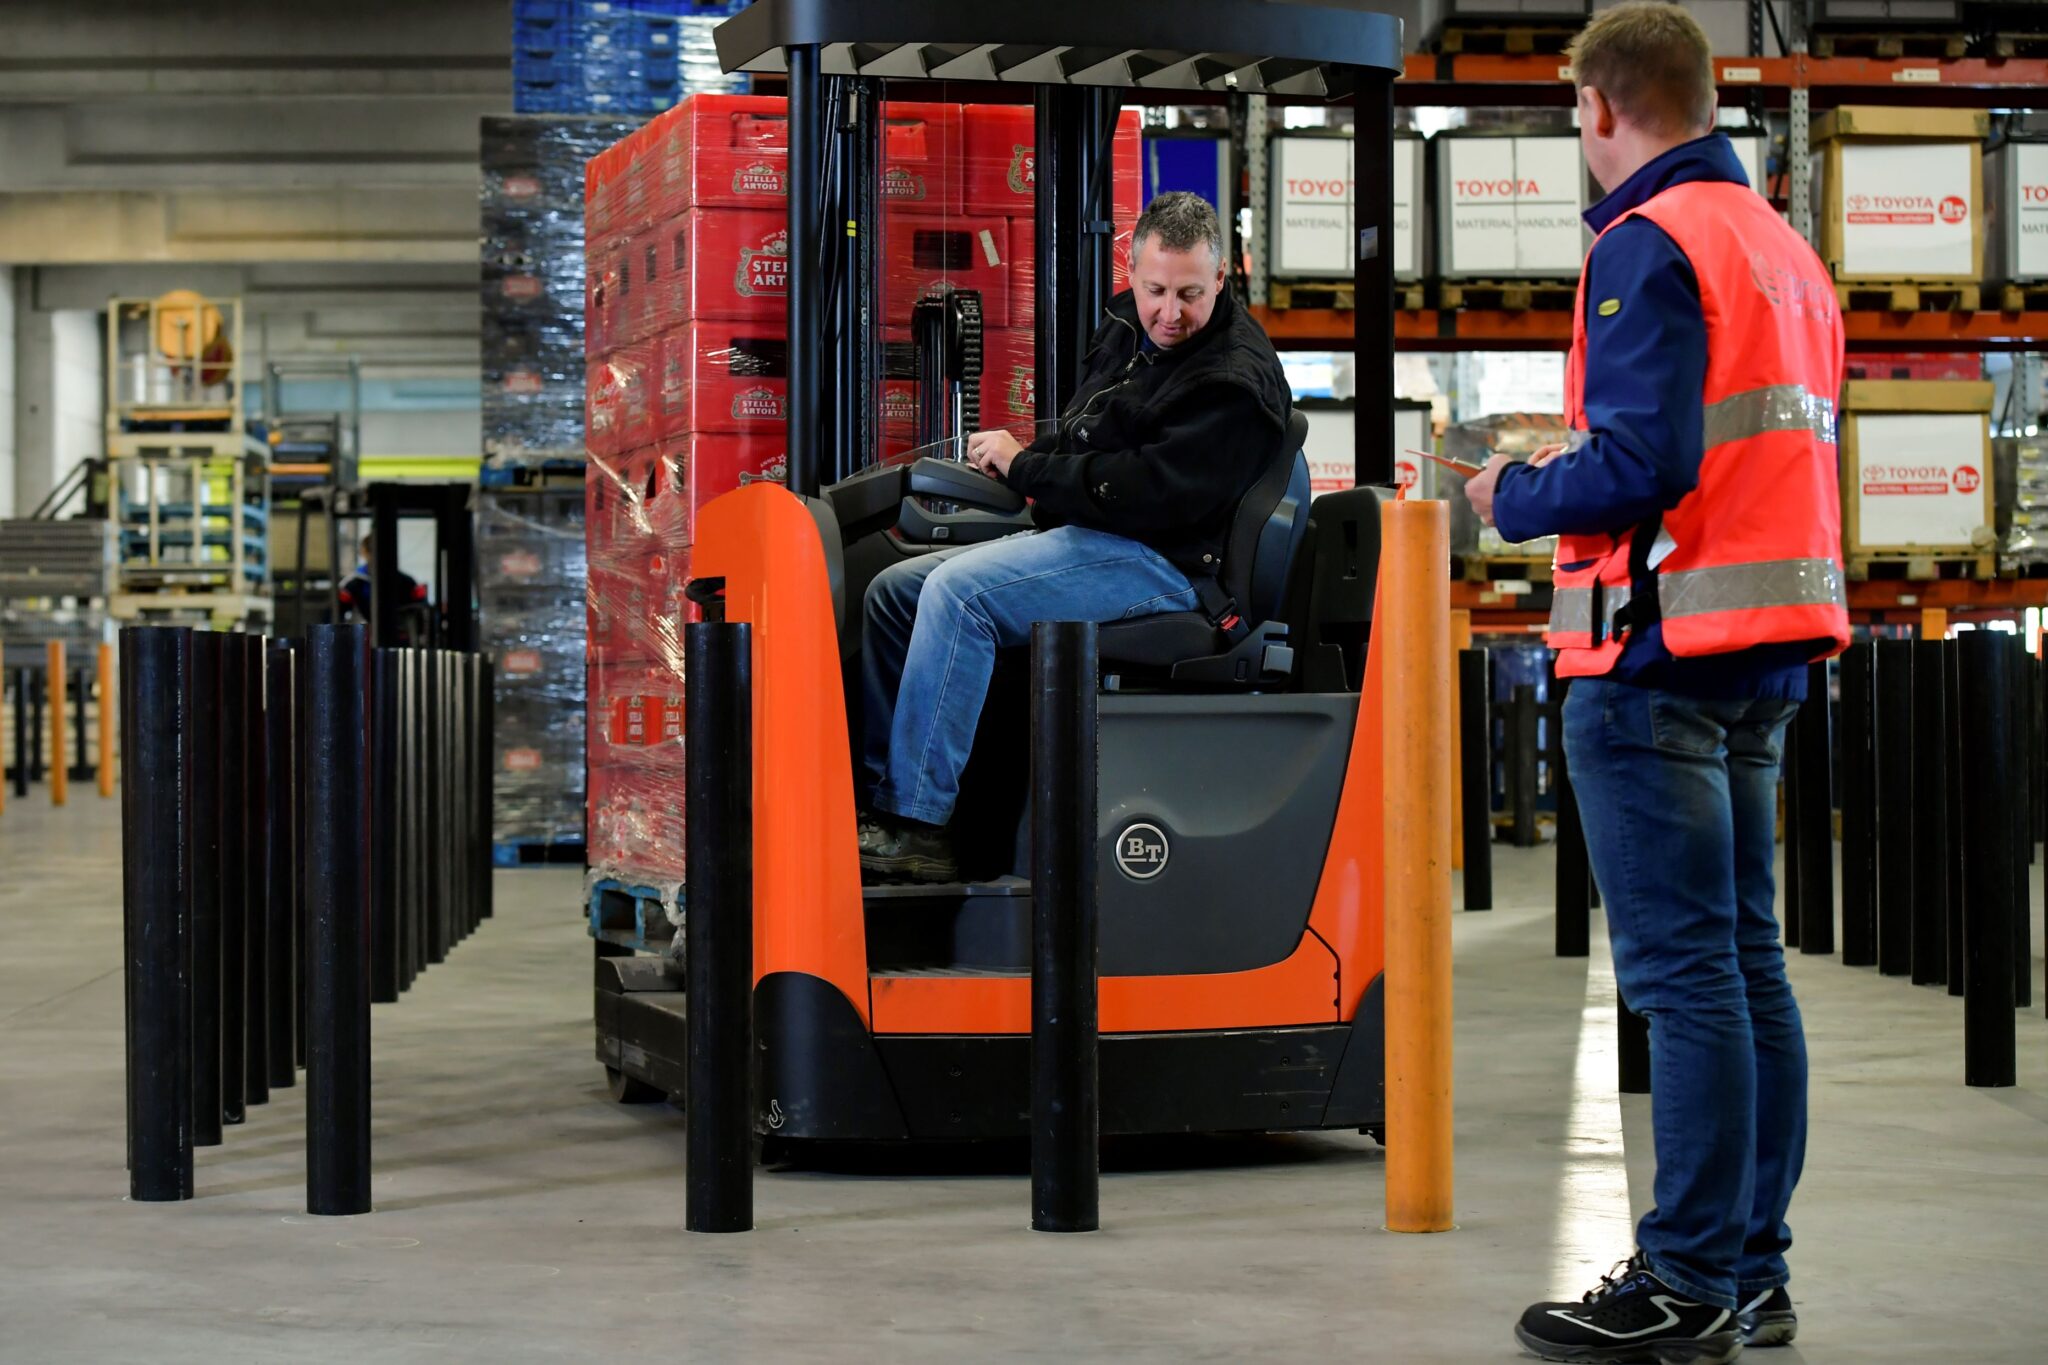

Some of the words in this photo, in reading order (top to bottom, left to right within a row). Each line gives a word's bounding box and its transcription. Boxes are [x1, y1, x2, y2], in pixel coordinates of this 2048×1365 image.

[742, 175, 778, 183] STELLA
[1287, 179, 1356, 197] TOYO
[1455, 179, 1540, 197] TOYOTA
[1874, 195, 1934, 209] TOYOTA
[1286, 218, 1343, 230] MATERIAL
[1455, 217, 1513, 230] MATERIAL
[1515, 216, 1579, 229] HANDLING
[752, 274, 787, 286] ART
[741, 400, 777, 408] STELLA
[741, 407, 777, 415] ARTOIS
[1323, 462, 1354, 475] TOY
[1889, 466, 1948, 479] TOYOTA
[1127, 837, 1162, 863] BT
